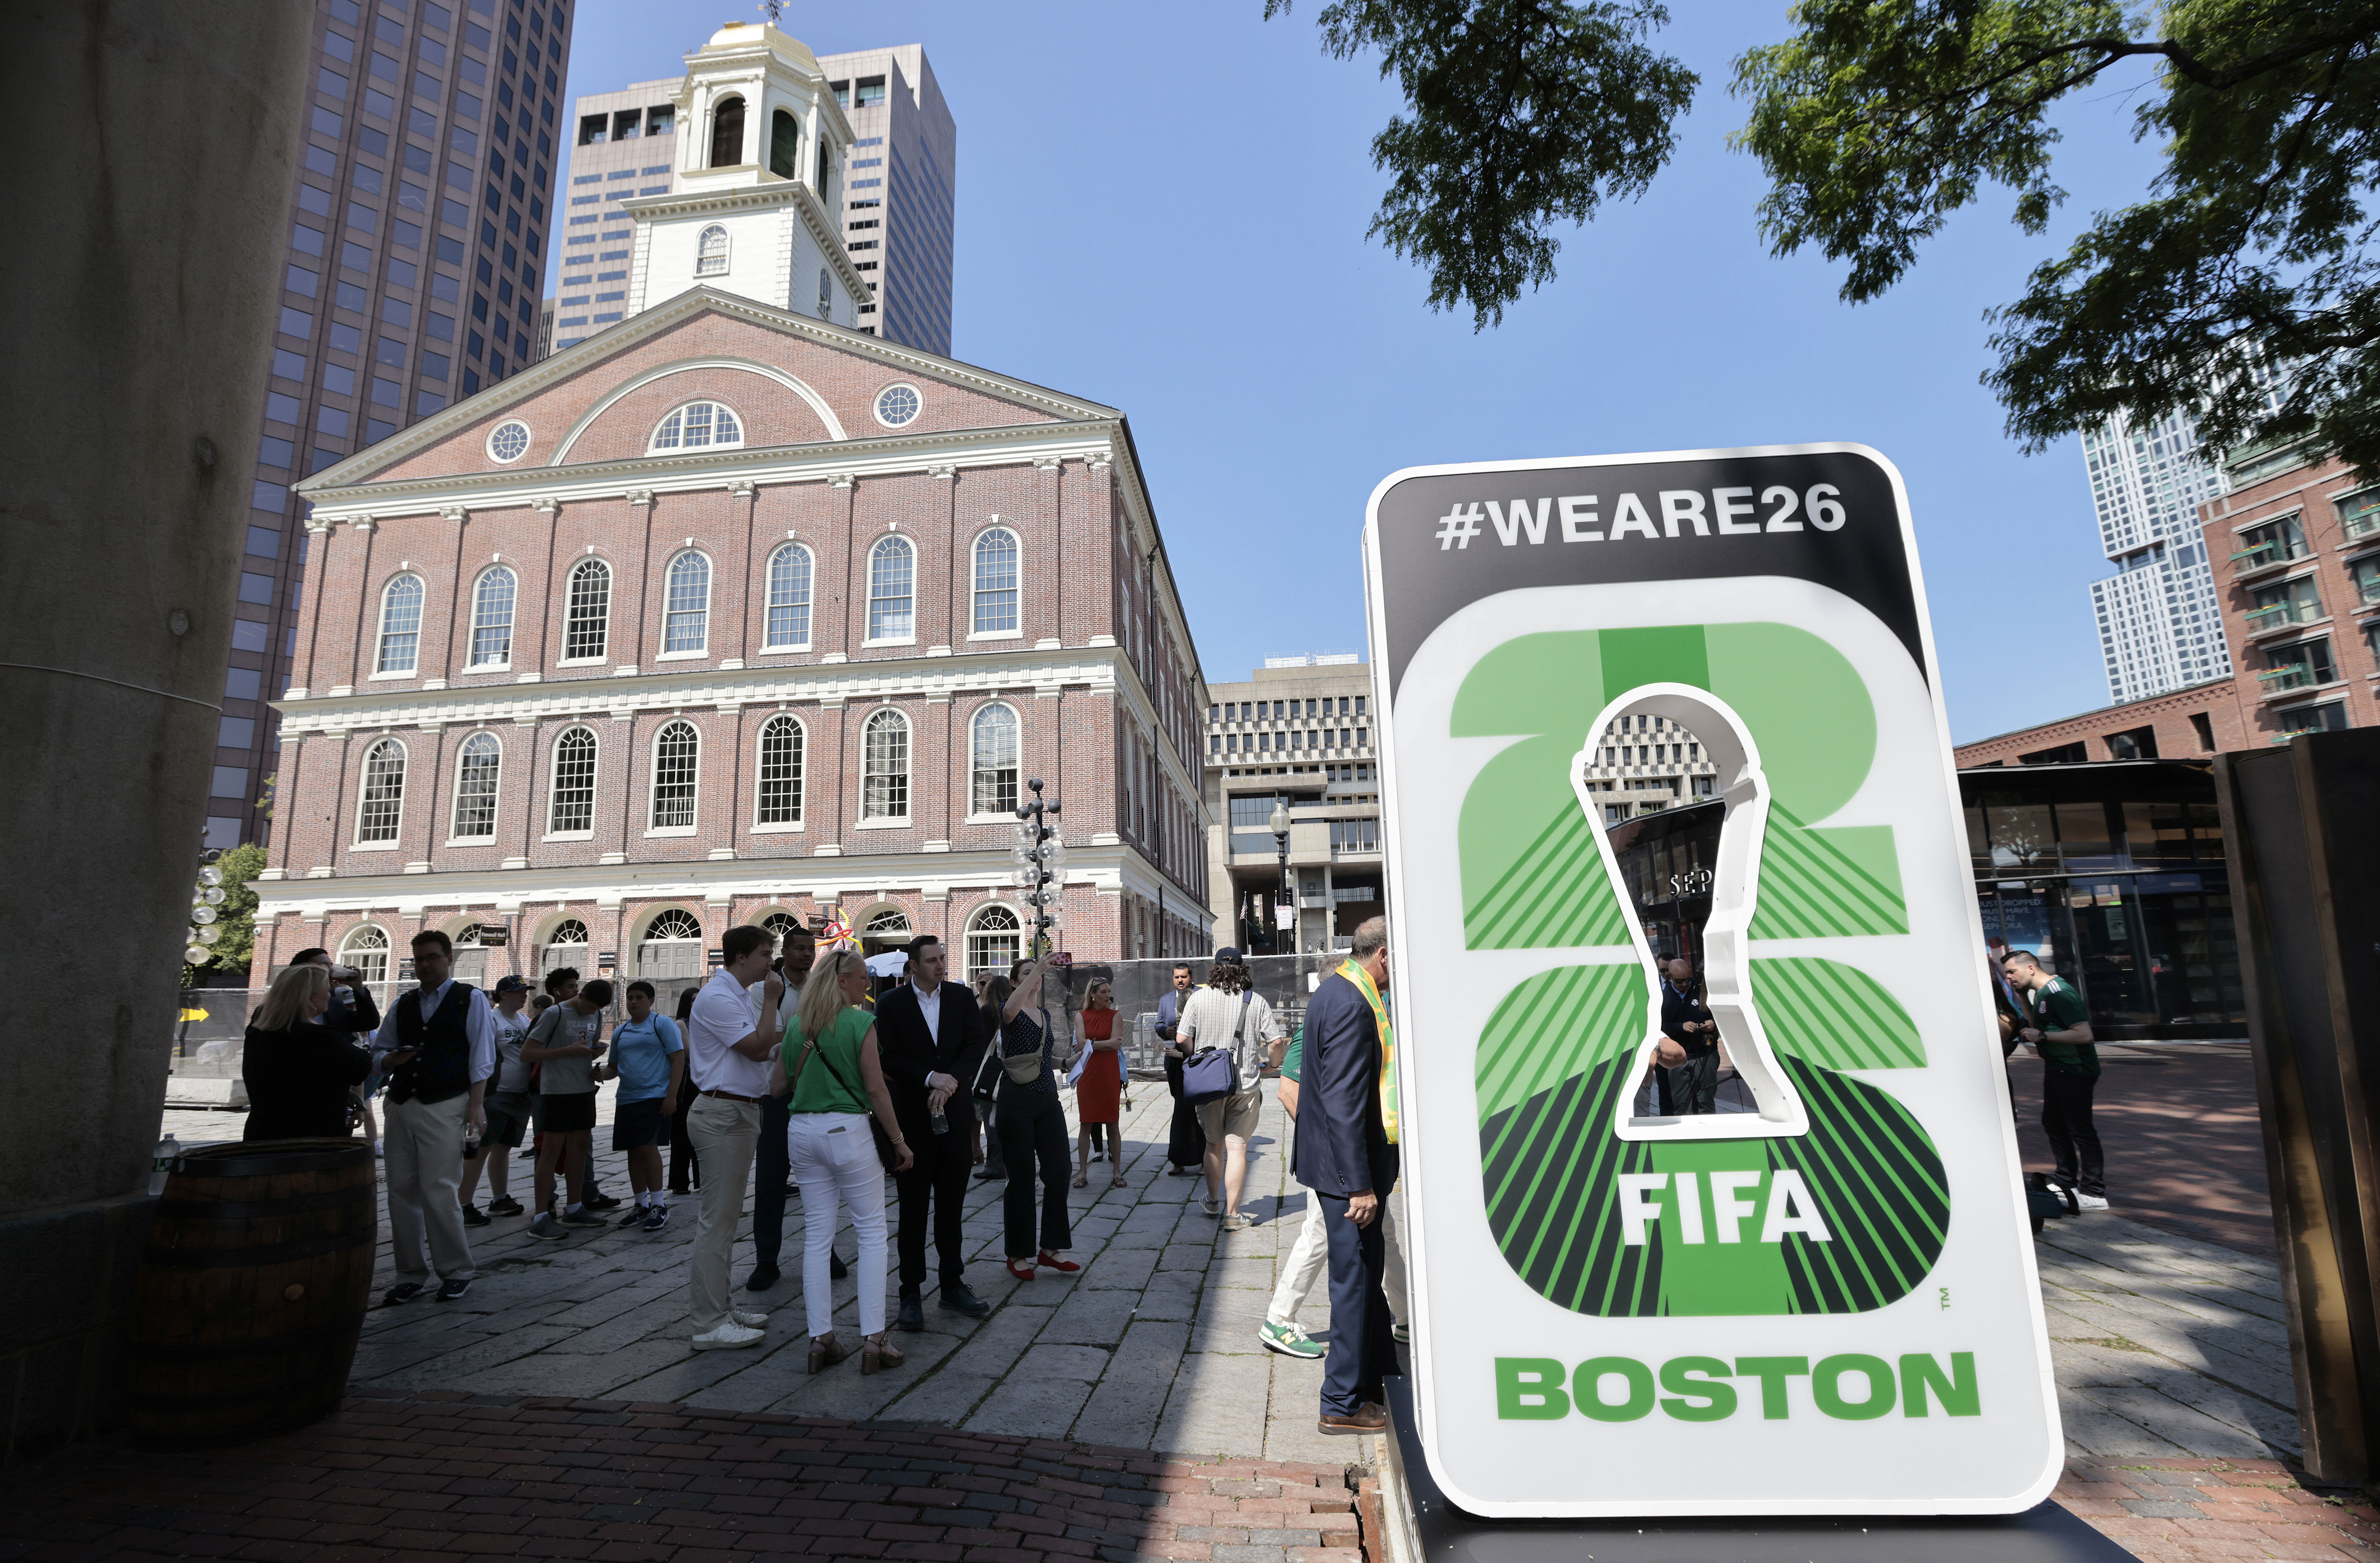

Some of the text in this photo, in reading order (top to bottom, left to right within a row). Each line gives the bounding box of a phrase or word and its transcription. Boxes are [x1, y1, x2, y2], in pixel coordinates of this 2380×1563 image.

[1435, 483, 1846, 551] #WEARE26
[1618, 1169, 1833, 1246] FIFA
[1939, 1288, 1950, 1311] TM
[1494, 1351, 1982, 1423] BOSTON
